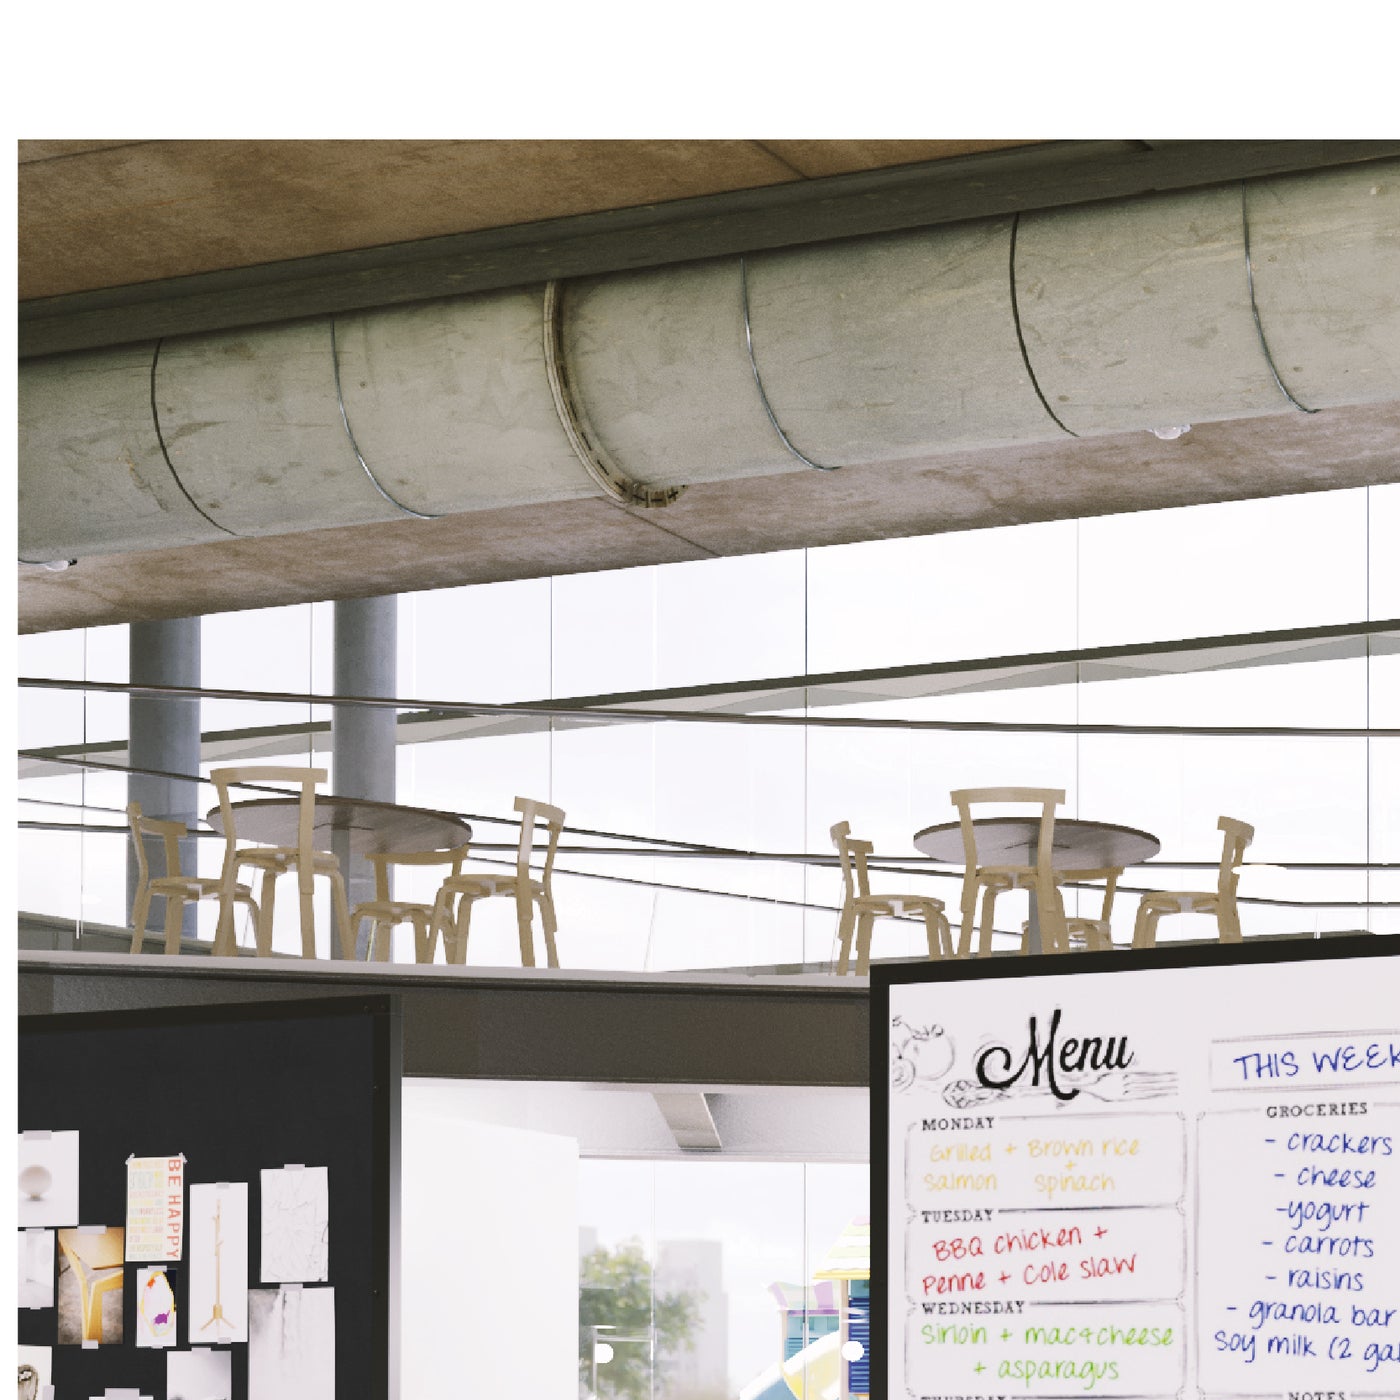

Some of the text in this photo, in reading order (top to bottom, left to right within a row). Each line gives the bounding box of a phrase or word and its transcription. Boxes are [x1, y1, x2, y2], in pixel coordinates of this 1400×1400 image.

[975, 1008, 1134, 1101] Menu
[1233, 1053, 1299, 1080] THIS
[1266, 1103, 1368, 1118] GROCERIES
[922, 1117, 995, 1131] MONDAY
[1102, 1138, 1140, 1156] rice
[1287, 1132, 1393, 1155] crackers
[1298, 1166, 1377, 1188] cheese
[166, 1159, 181, 1257] BE HAPPY
[922, 1209, 993, 1223] TUESDAY
[932, 1237, 984, 1261] BBQ
[1285, 1235, 1374, 1258] carrots
[1287, 1268, 1365, 1291] raisins
[922, 1301, 1025, 1315] WEDNESDAY
[1249, 1300, 1340, 1329] granola
[1352, 1305, 1398, 1327] bar
[1268, 1336, 1317, 1357] milk
[1329, 1337, 1352, 1361] (2
[998, 1360, 1119, 1390] asparagus
